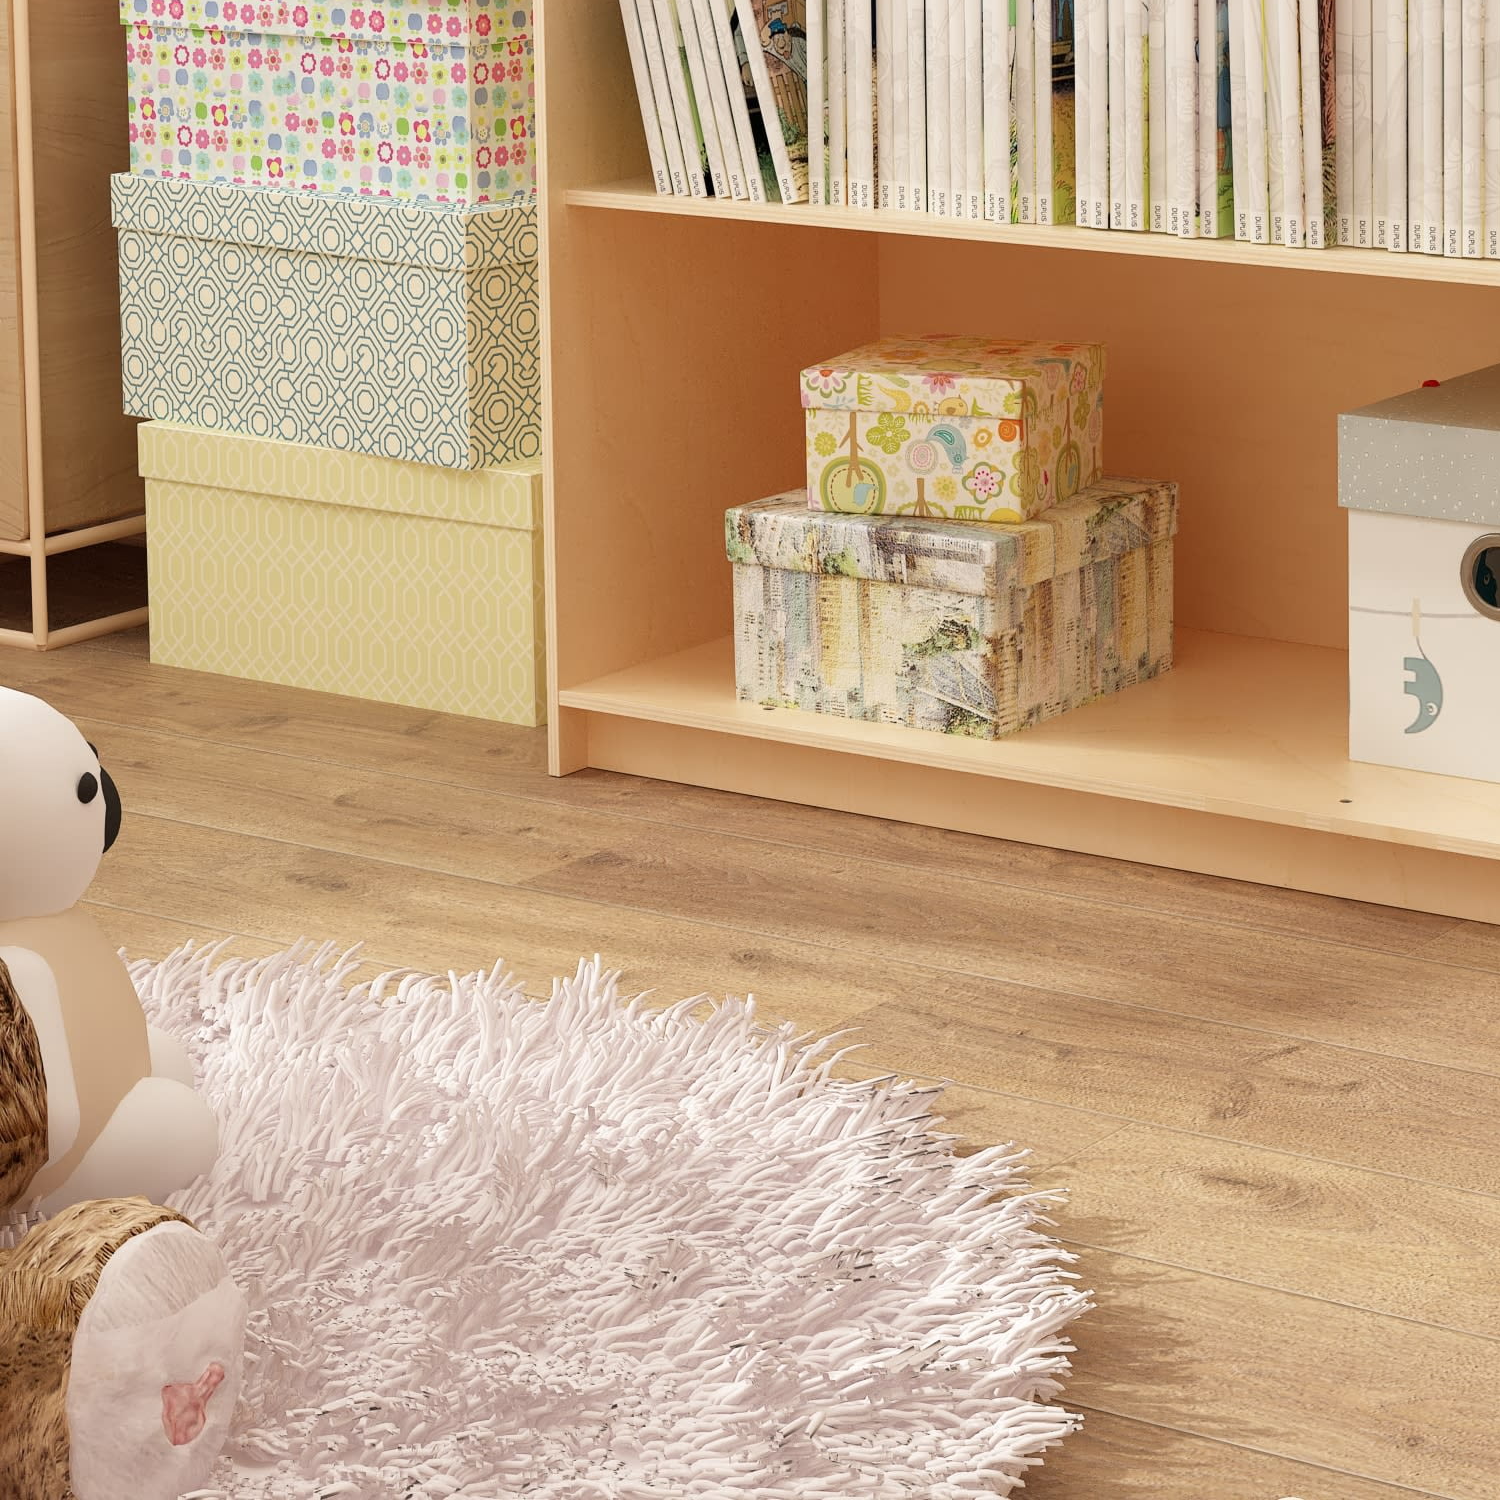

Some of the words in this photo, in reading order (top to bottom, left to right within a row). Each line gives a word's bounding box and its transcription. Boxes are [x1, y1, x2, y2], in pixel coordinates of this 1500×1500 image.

[656, 169, 666, 193] DUPUIS
[781, 177, 792, 201] DUPUIS
[1310, 220, 1318, 245] DUPUIS
[1413, 224, 1421, 249] DUPUIS
